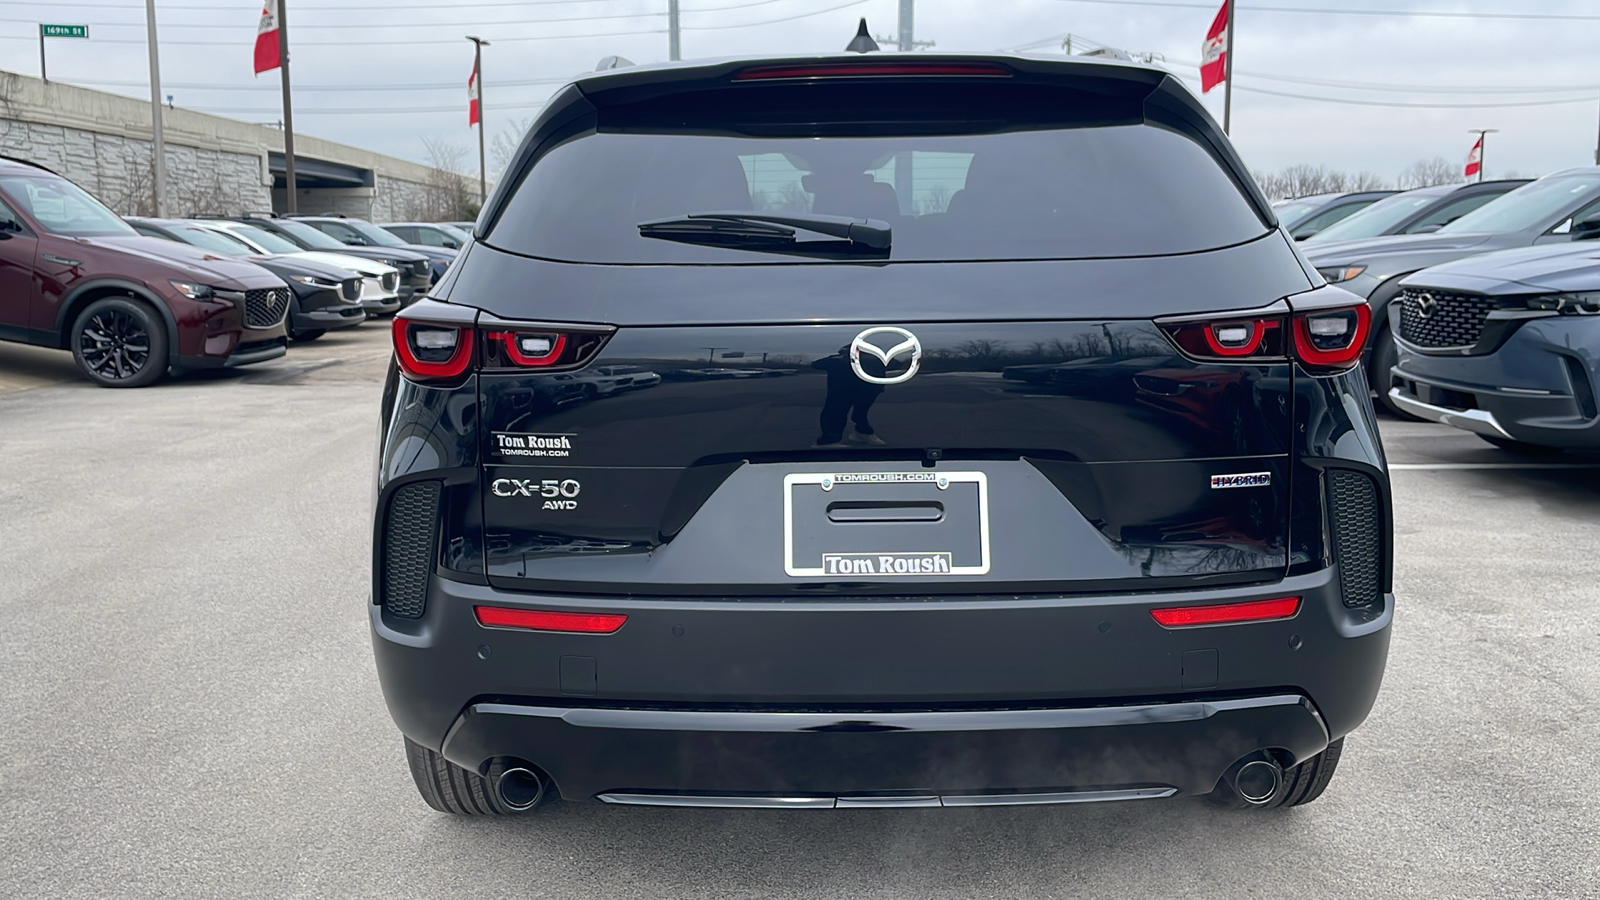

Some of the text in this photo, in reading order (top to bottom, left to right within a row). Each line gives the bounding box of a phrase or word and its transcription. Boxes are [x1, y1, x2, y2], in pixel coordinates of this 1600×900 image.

[497, 434, 571, 449] Tom Roush
[500, 448, 569, 457] TOMROUSH.COM
[835, 473, 935, 482] TOMROUSH.COM
[1214, 473, 1270, 487] HYBRID
[492, 478, 581, 498] CX-50
[541, 500, 578, 510] AWD
[825, 554, 950, 574] Tom Roush
